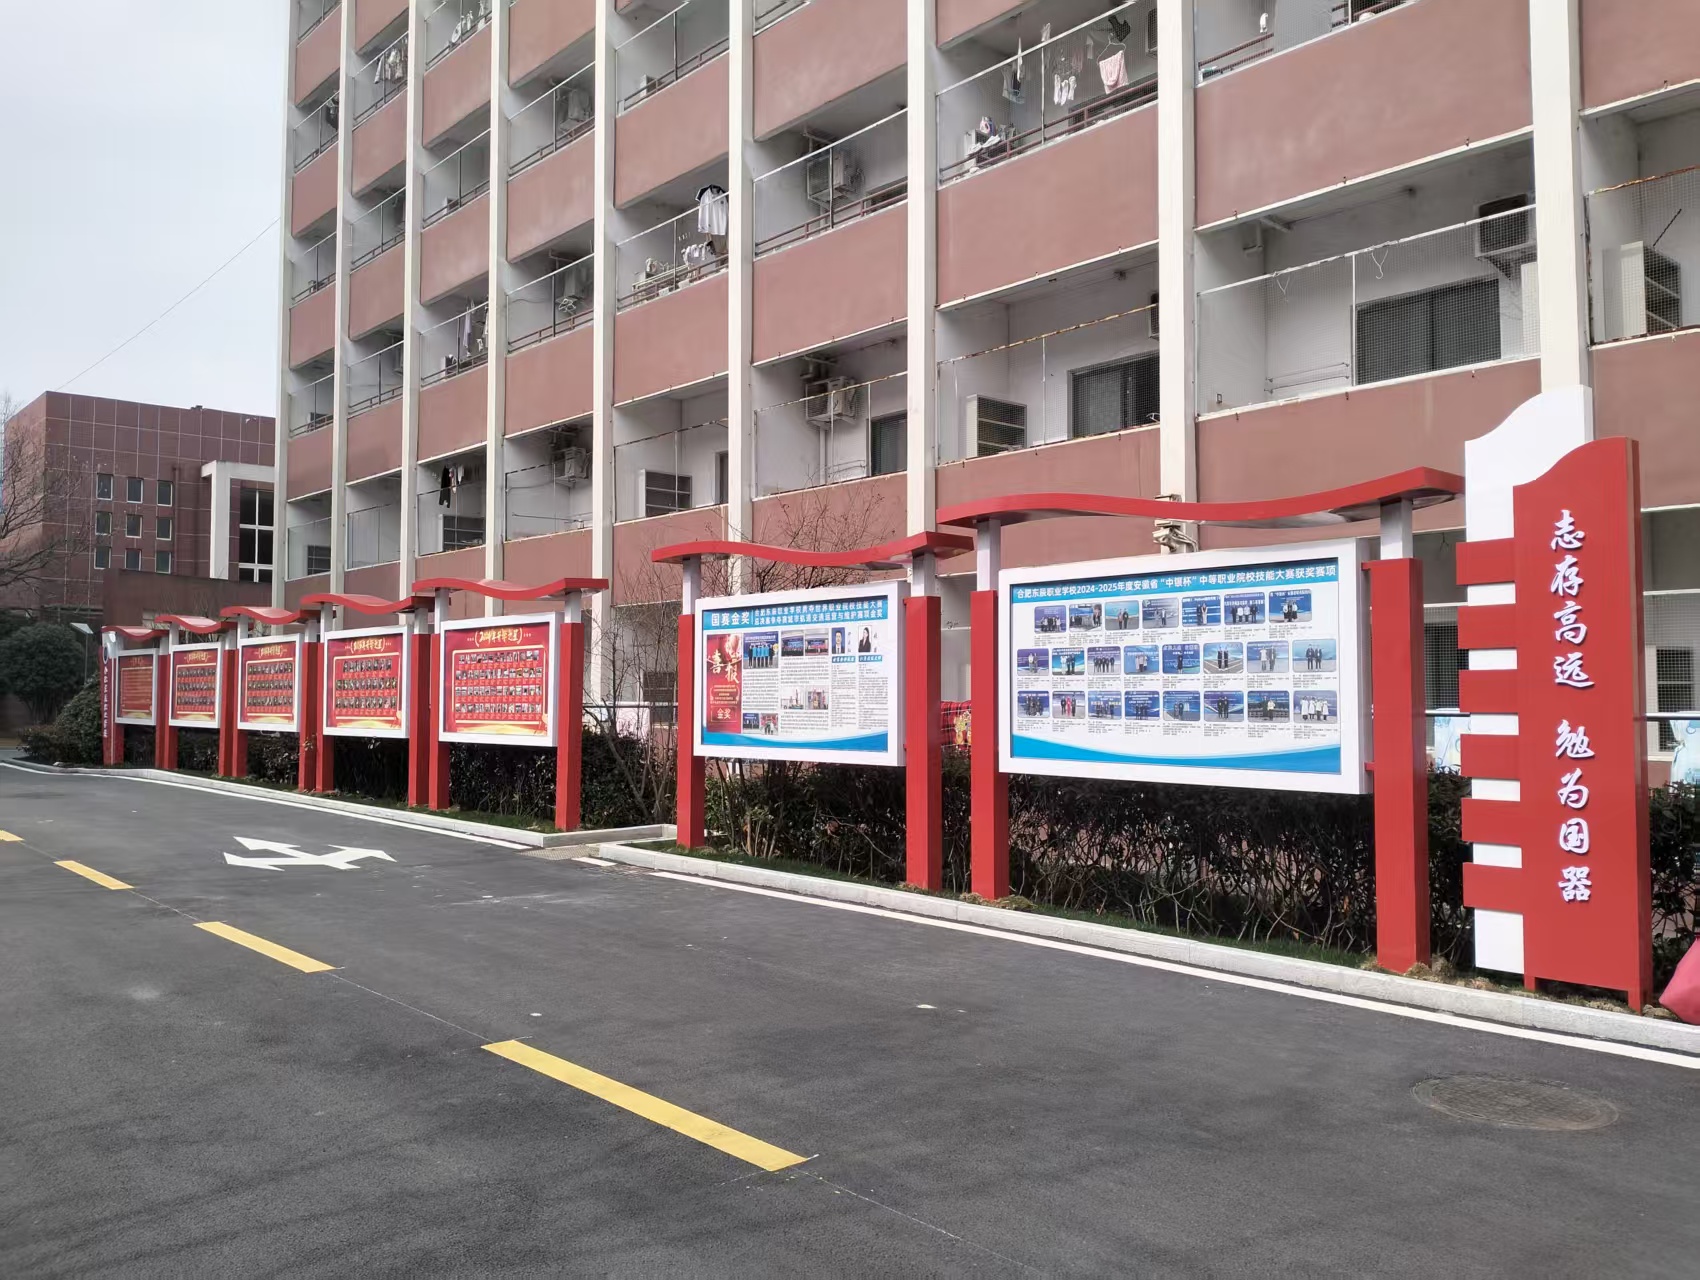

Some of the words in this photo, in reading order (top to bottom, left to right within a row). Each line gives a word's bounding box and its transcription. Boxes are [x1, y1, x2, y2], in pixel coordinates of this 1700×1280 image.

[711, 611, 750, 627] 国赛金奖
[1550, 509, 1595, 689] 志存高远
[708, 649, 740, 684] 喜报
[1554, 719, 1596, 903] 勉为国器
